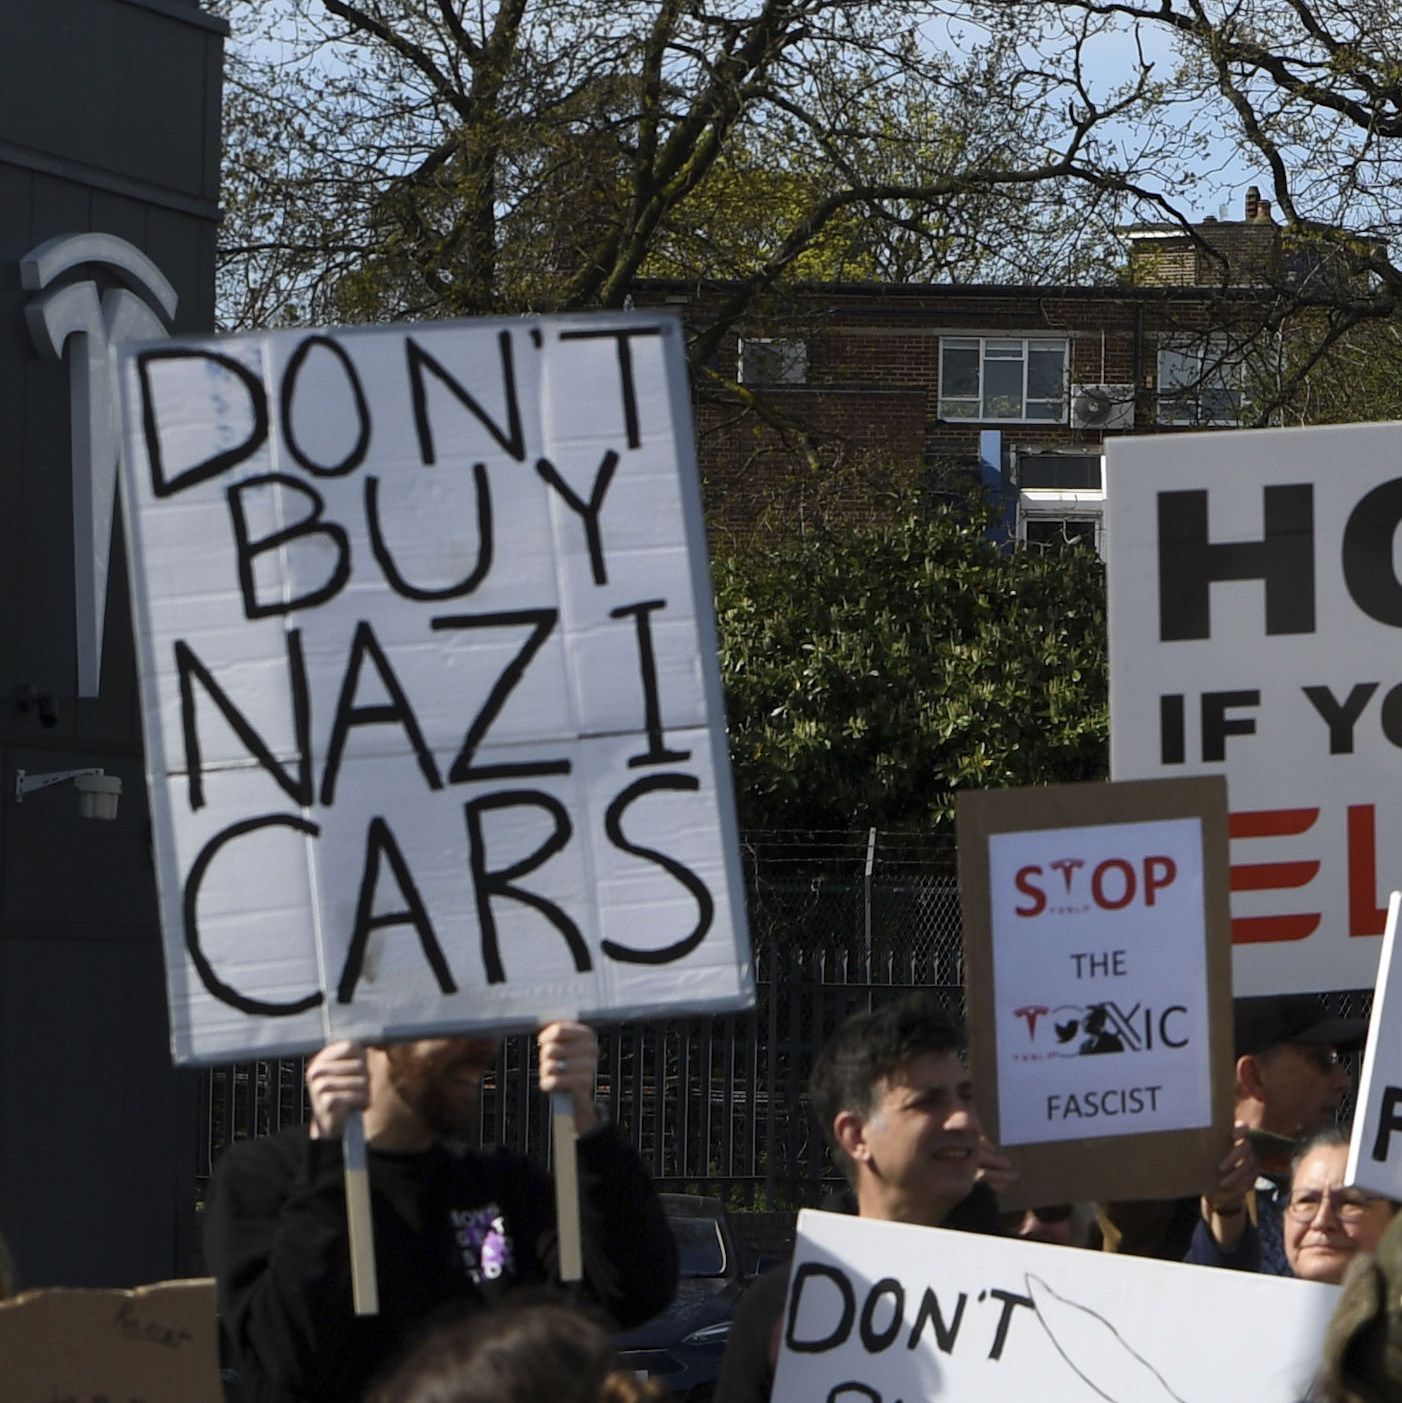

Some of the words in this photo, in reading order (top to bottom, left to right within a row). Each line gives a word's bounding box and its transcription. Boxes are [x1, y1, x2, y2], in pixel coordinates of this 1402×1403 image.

[136, 327, 667, 498] DON'T
[226, 451, 620, 619] BUY
[175, 600, 693, 812] NAZI
[1160, 689, 1262, 765] IF
[183, 773, 715, 1017] CARS
[1014, 855, 1177, 918] STOP
[1070, 950, 1127, 980] THE
[1047, 1085, 1163, 1122] FASCIST
[785, 1261, 1036, 1362] DON'T
